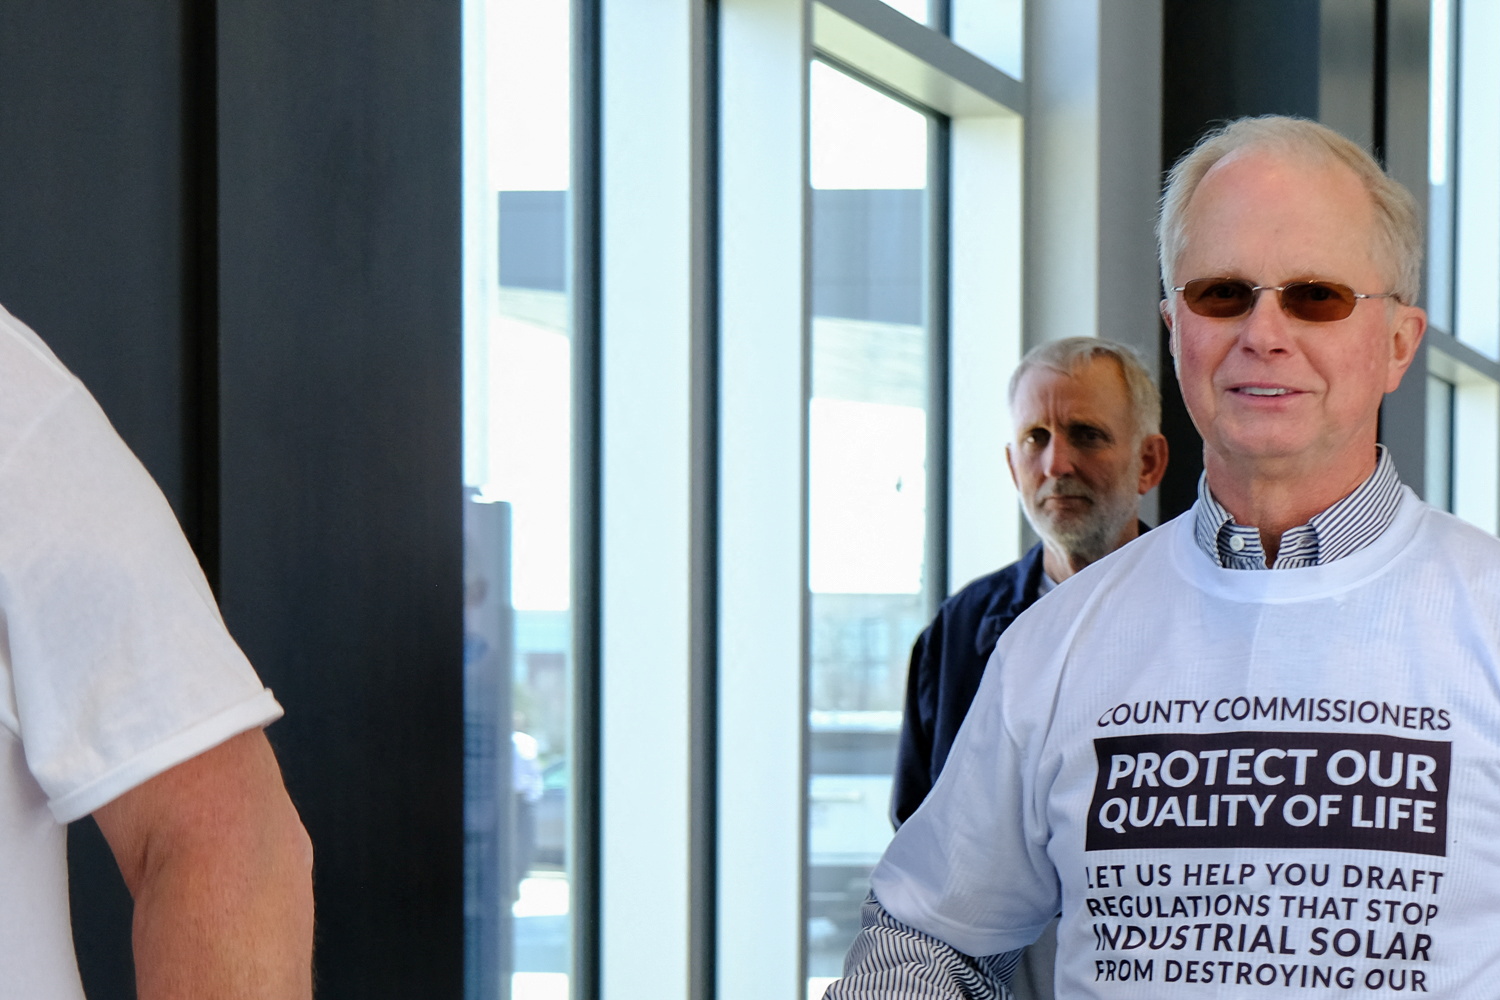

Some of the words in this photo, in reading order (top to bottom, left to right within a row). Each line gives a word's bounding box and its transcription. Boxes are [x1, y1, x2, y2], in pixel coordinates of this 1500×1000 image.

[1098, 700, 1209, 727] COUNTY
[1214, 696, 1450, 730] COMMISSIONERS
[1107, 749, 1318, 789] PROTECT
[1327, 750, 1437, 791] OUR
[1099, 795, 1276, 833] QUALITY
[1283, 795, 1342, 826] OF
[1352, 795, 1436, 833] LIFE
[1137, 864, 1171, 886] US
[1184, 864, 1255, 886] HELP
[1266, 864, 1329, 886] YOU
[1343, 865, 1443, 894] DRAFT
[1086, 895, 1270, 918] REGULATIONS
[1280, 896, 1358, 920] THAT
[1367, 899, 1438, 926] STOP
[1093, 923, 1295, 954] INDUSTRIAL
[1309, 927, 1431, 961] SOLAR
[1095, 959, 1153, 981] FROM
[1165, 960, 1355, 989] DESTROYING
[1365, 969, 1427, 992] OUR
